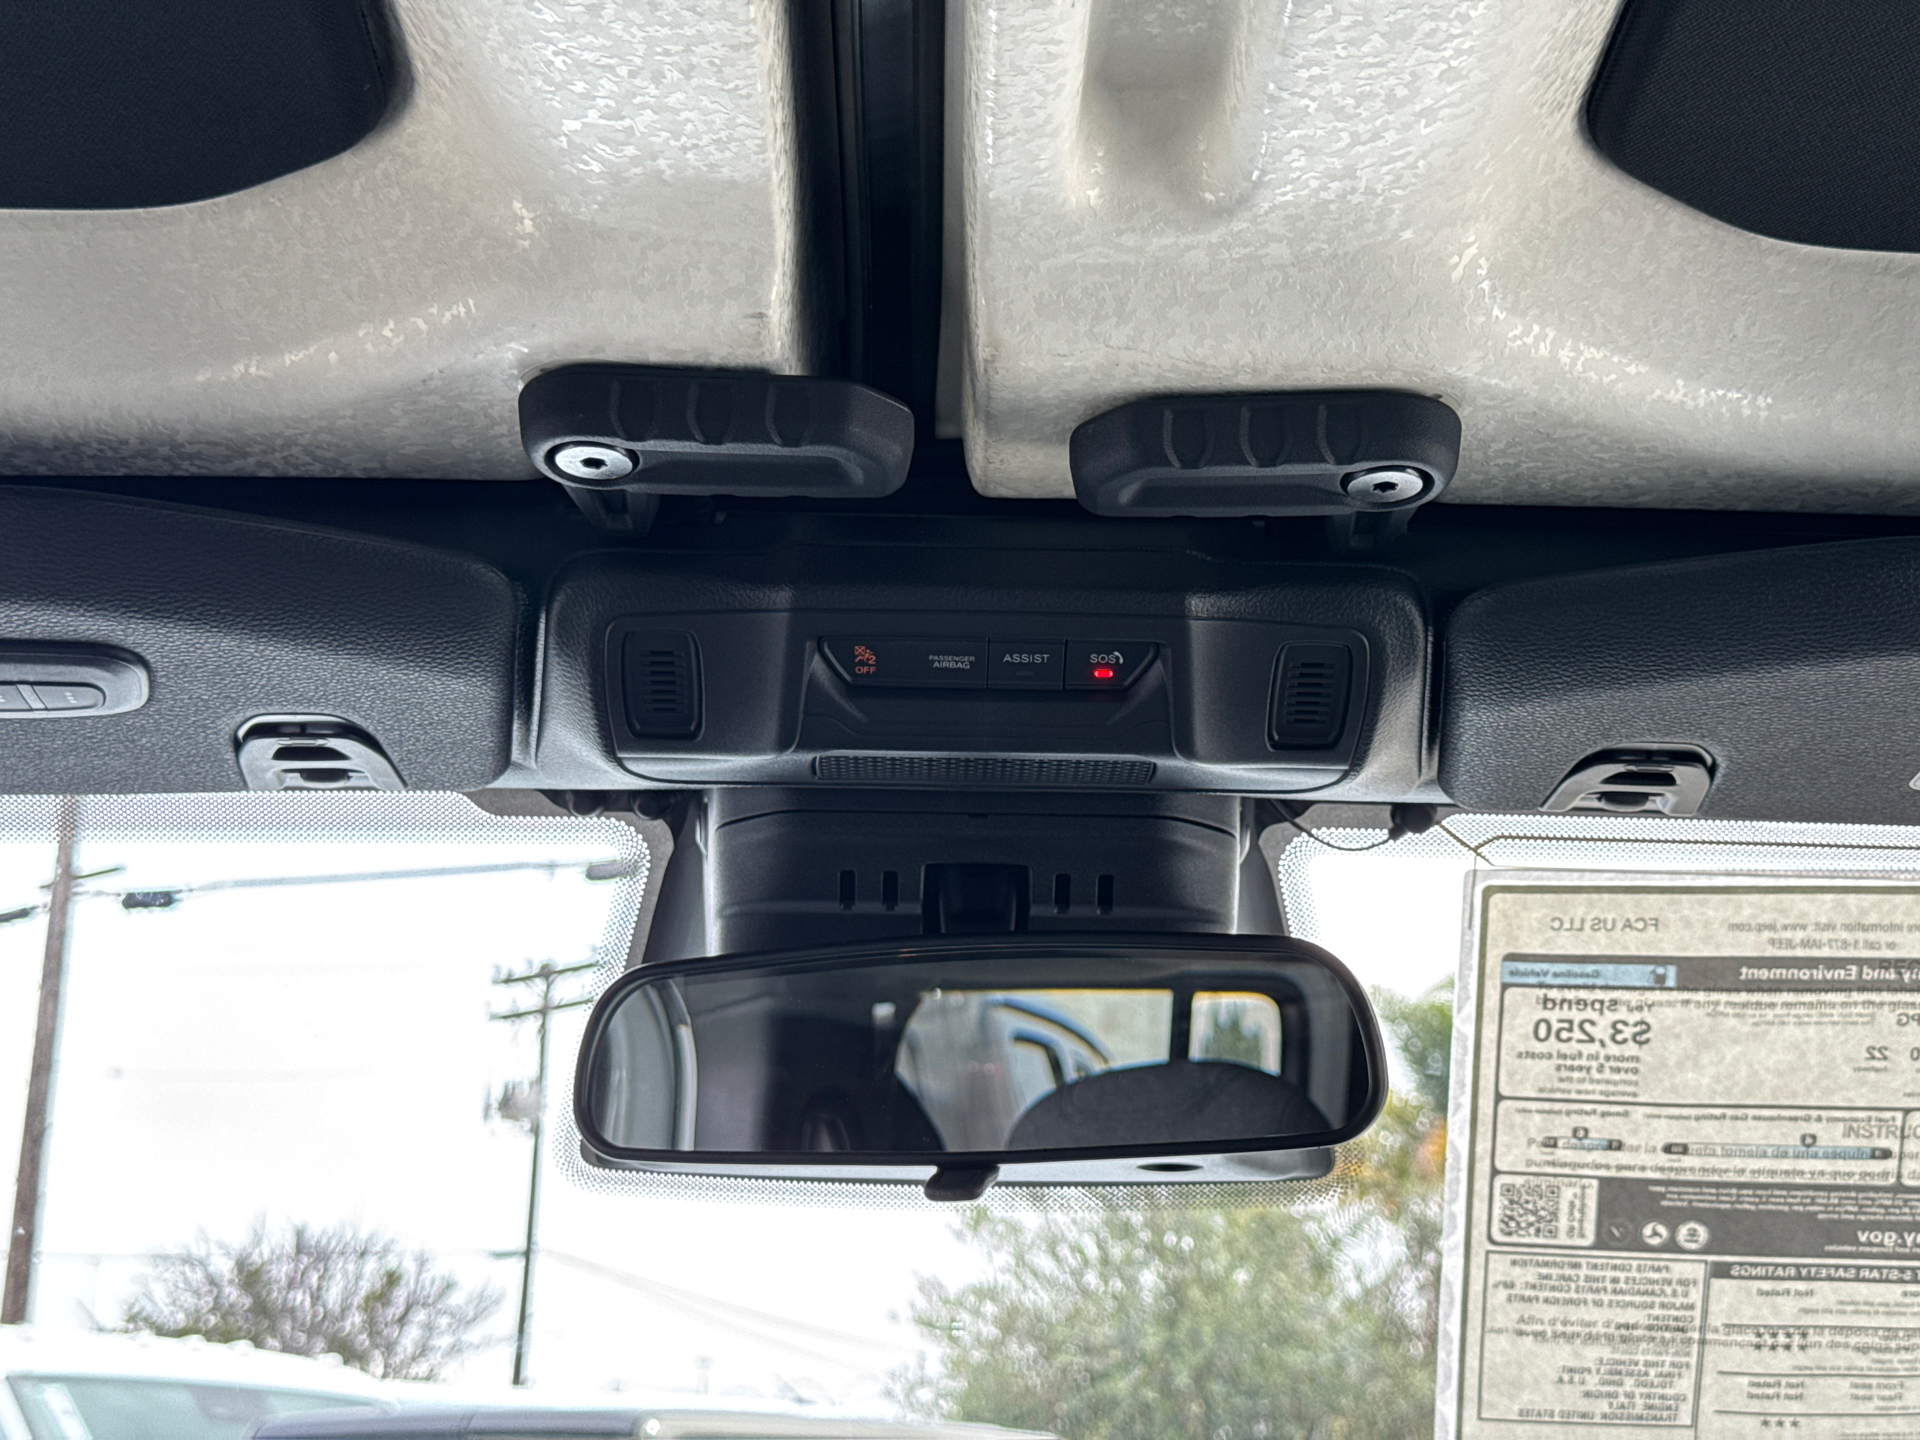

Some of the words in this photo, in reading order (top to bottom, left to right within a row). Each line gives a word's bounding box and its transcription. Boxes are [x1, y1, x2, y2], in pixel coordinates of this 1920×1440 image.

[1003, 654, 1050, 663] ASSIST
[1090, 654, 1116, 664] SOS
[933, 661, 970, 669] AIRBAG
[855, 666, 876, 674] OFF
